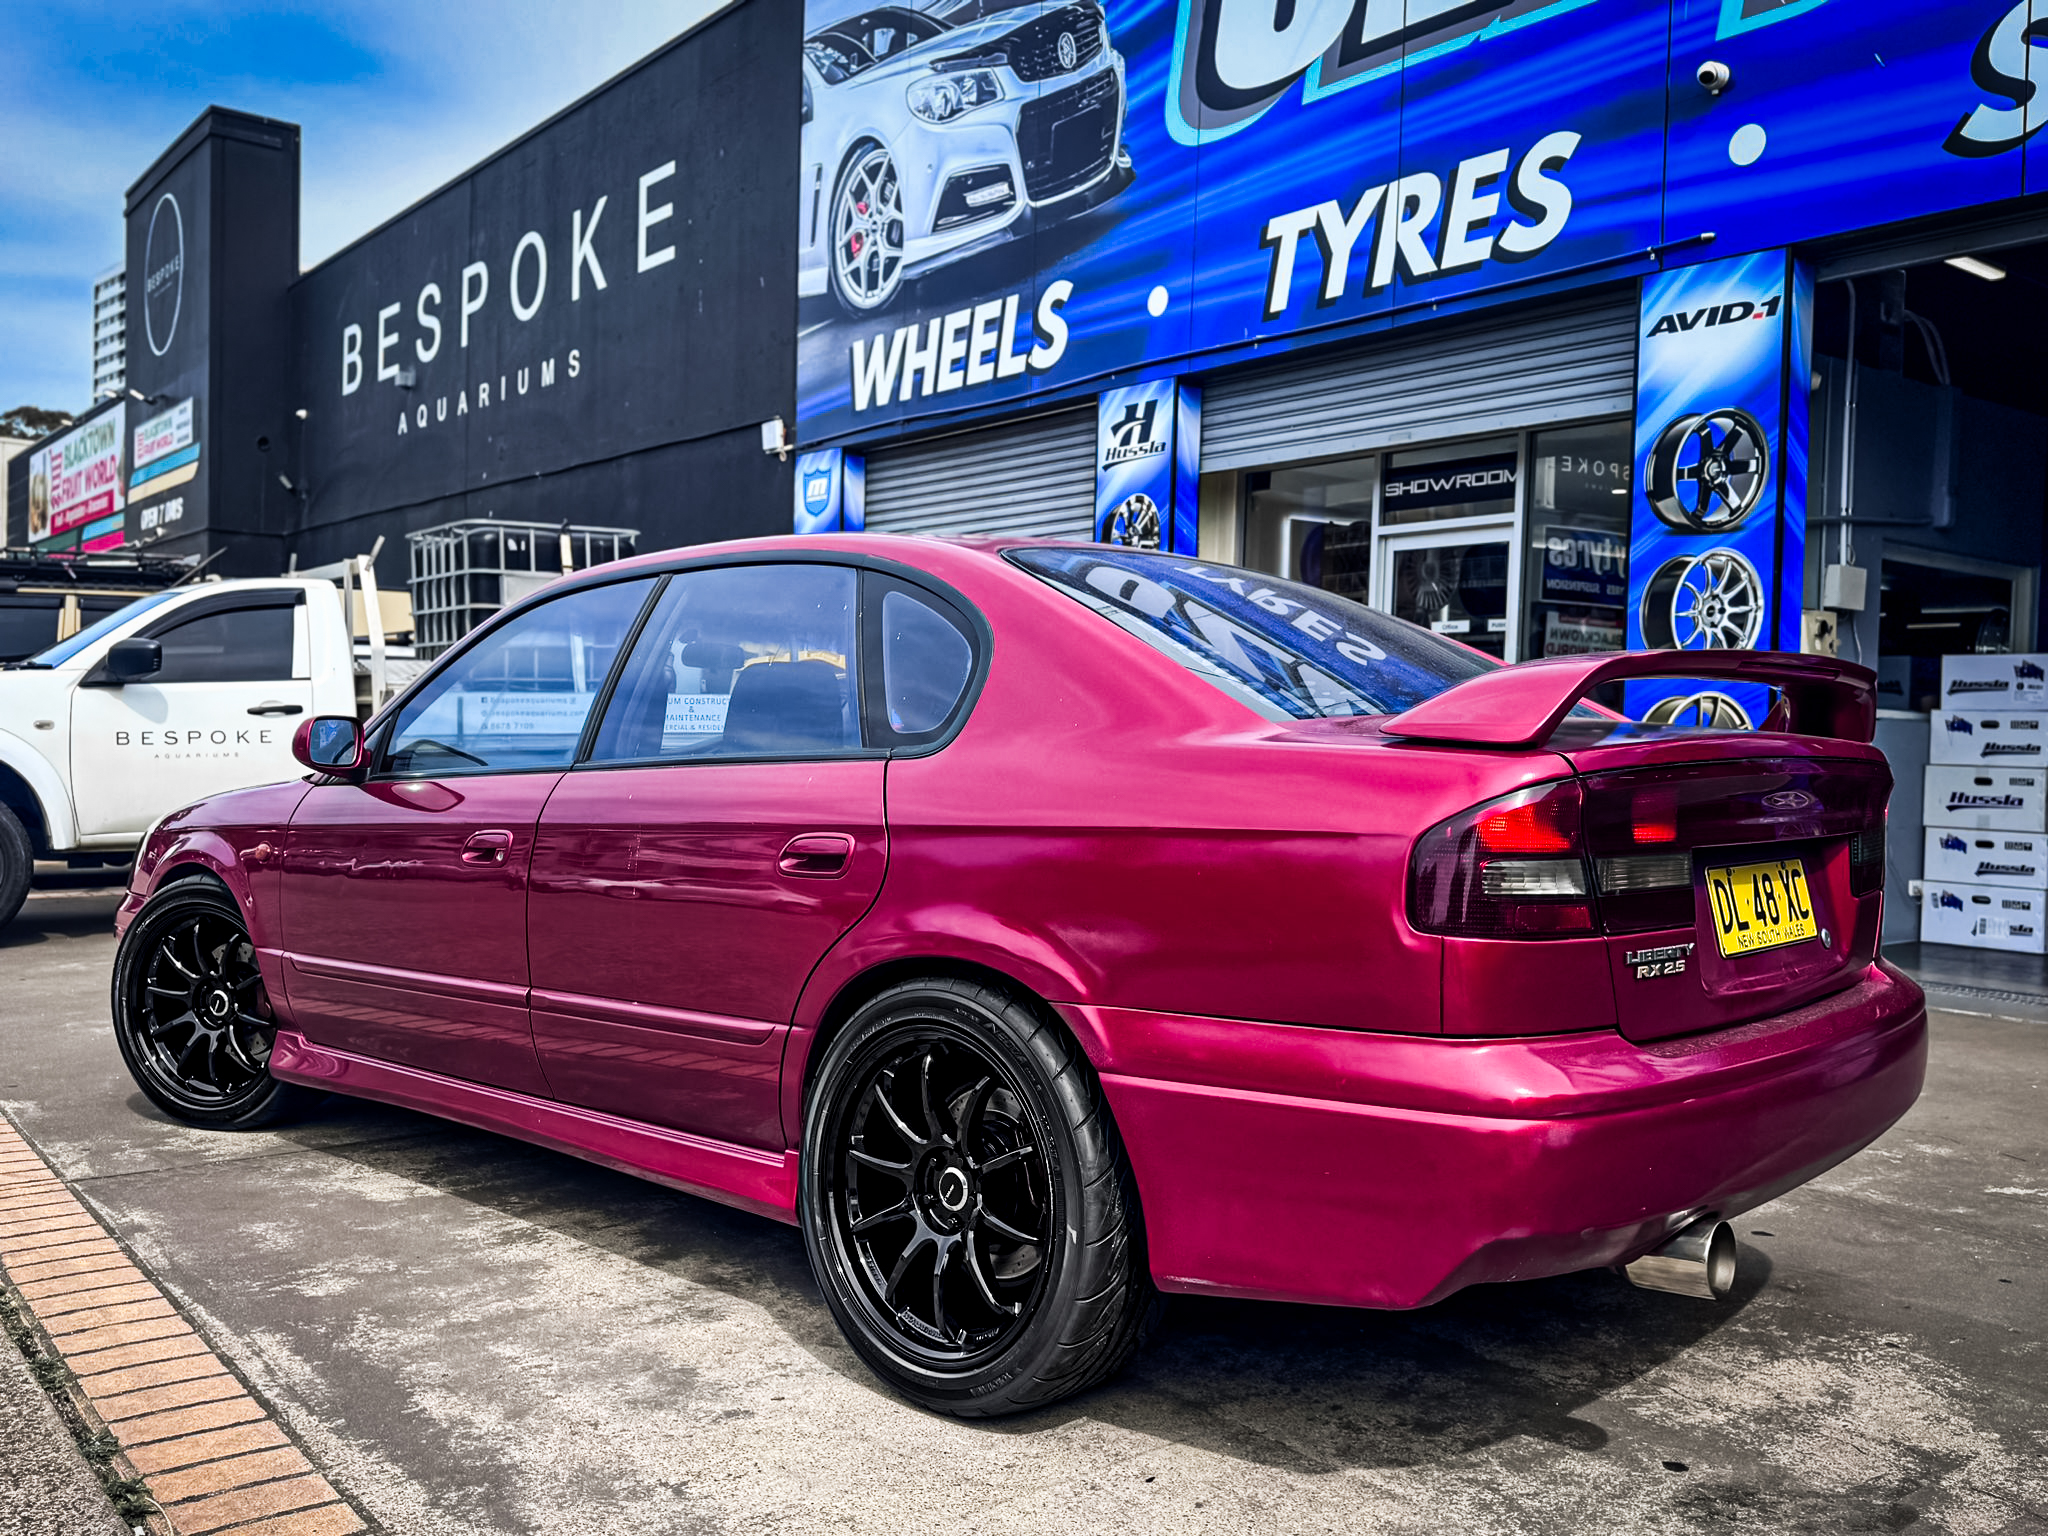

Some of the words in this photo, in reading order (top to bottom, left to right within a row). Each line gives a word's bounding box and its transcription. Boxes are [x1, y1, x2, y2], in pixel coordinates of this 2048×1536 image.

[1265, 130, 1583, 314] TYRES
[146, 254, 181, 293] BESPOKE
[341, 159, 677, 397] BESPOKE
[1645, 294, 1783, 339] AVID.1
[851, 279, 1075, 412] WHEELS
[396, 349, 581, 436] AQUARIUMS
[85, 454, 116, 495] WORLD
[1384, 468, 1518, 498] SHOWROOM
[115, 729, 273, 746] BESPOKE
[153, 751, 240, 760] AQUARIUMS
[1948, 791, 2025, 809] Hussla
[1738, 933, 1755, 948] NEW
[1757, 927, 1781, 945] SOUTH
[1784, 922, 1805, 940] WALES
[1625, 943, 1696, 965] LIBERTY
[1636, 963, 1662, 979] RX
